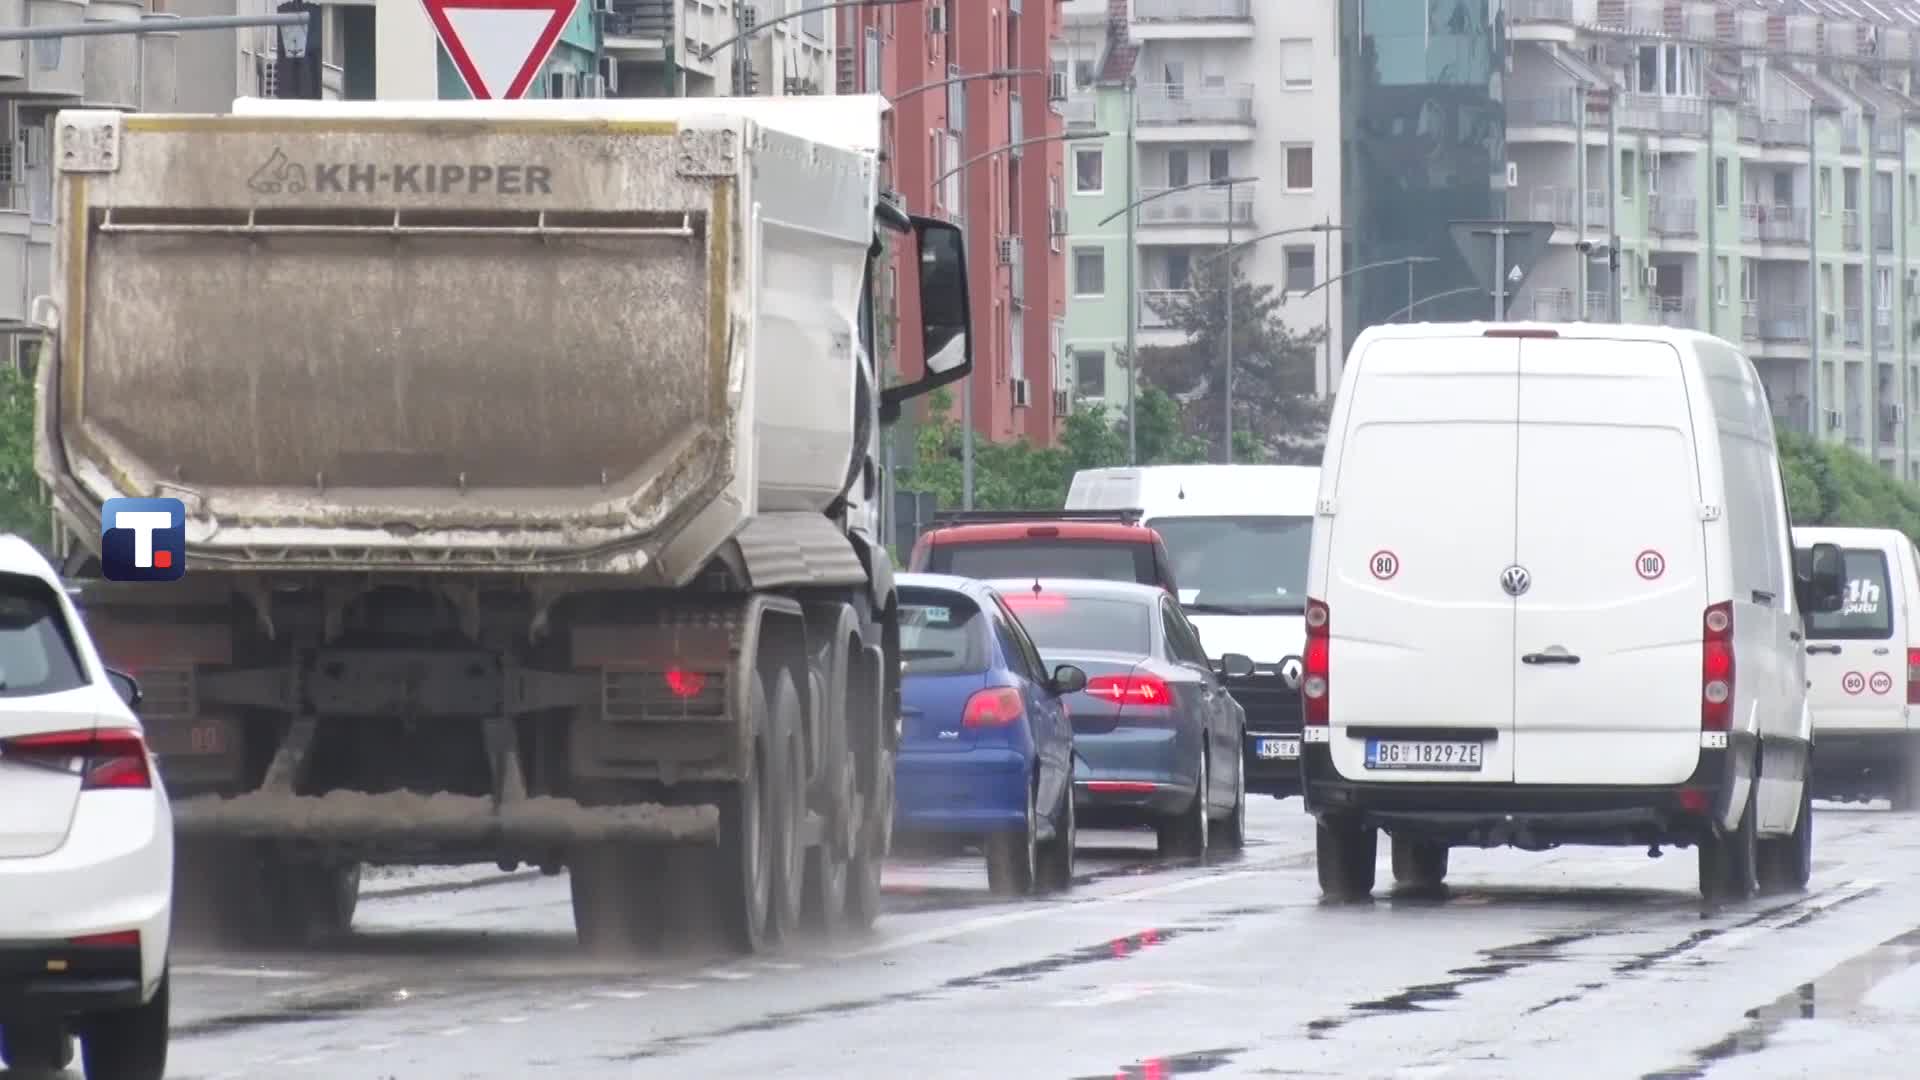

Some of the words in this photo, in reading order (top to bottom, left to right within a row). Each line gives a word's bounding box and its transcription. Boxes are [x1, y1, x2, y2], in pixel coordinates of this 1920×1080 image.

[315, 163, 553, 195] KH-KIPPER
[1376, 557, 1392, 574] 80
[1641, 557, 1659, 573] 100
[1264, 743, 1280, 754] NS
[1380, 744, 1399, 762] BG
[1414, 744, 1478, 763] 1829-ZE
